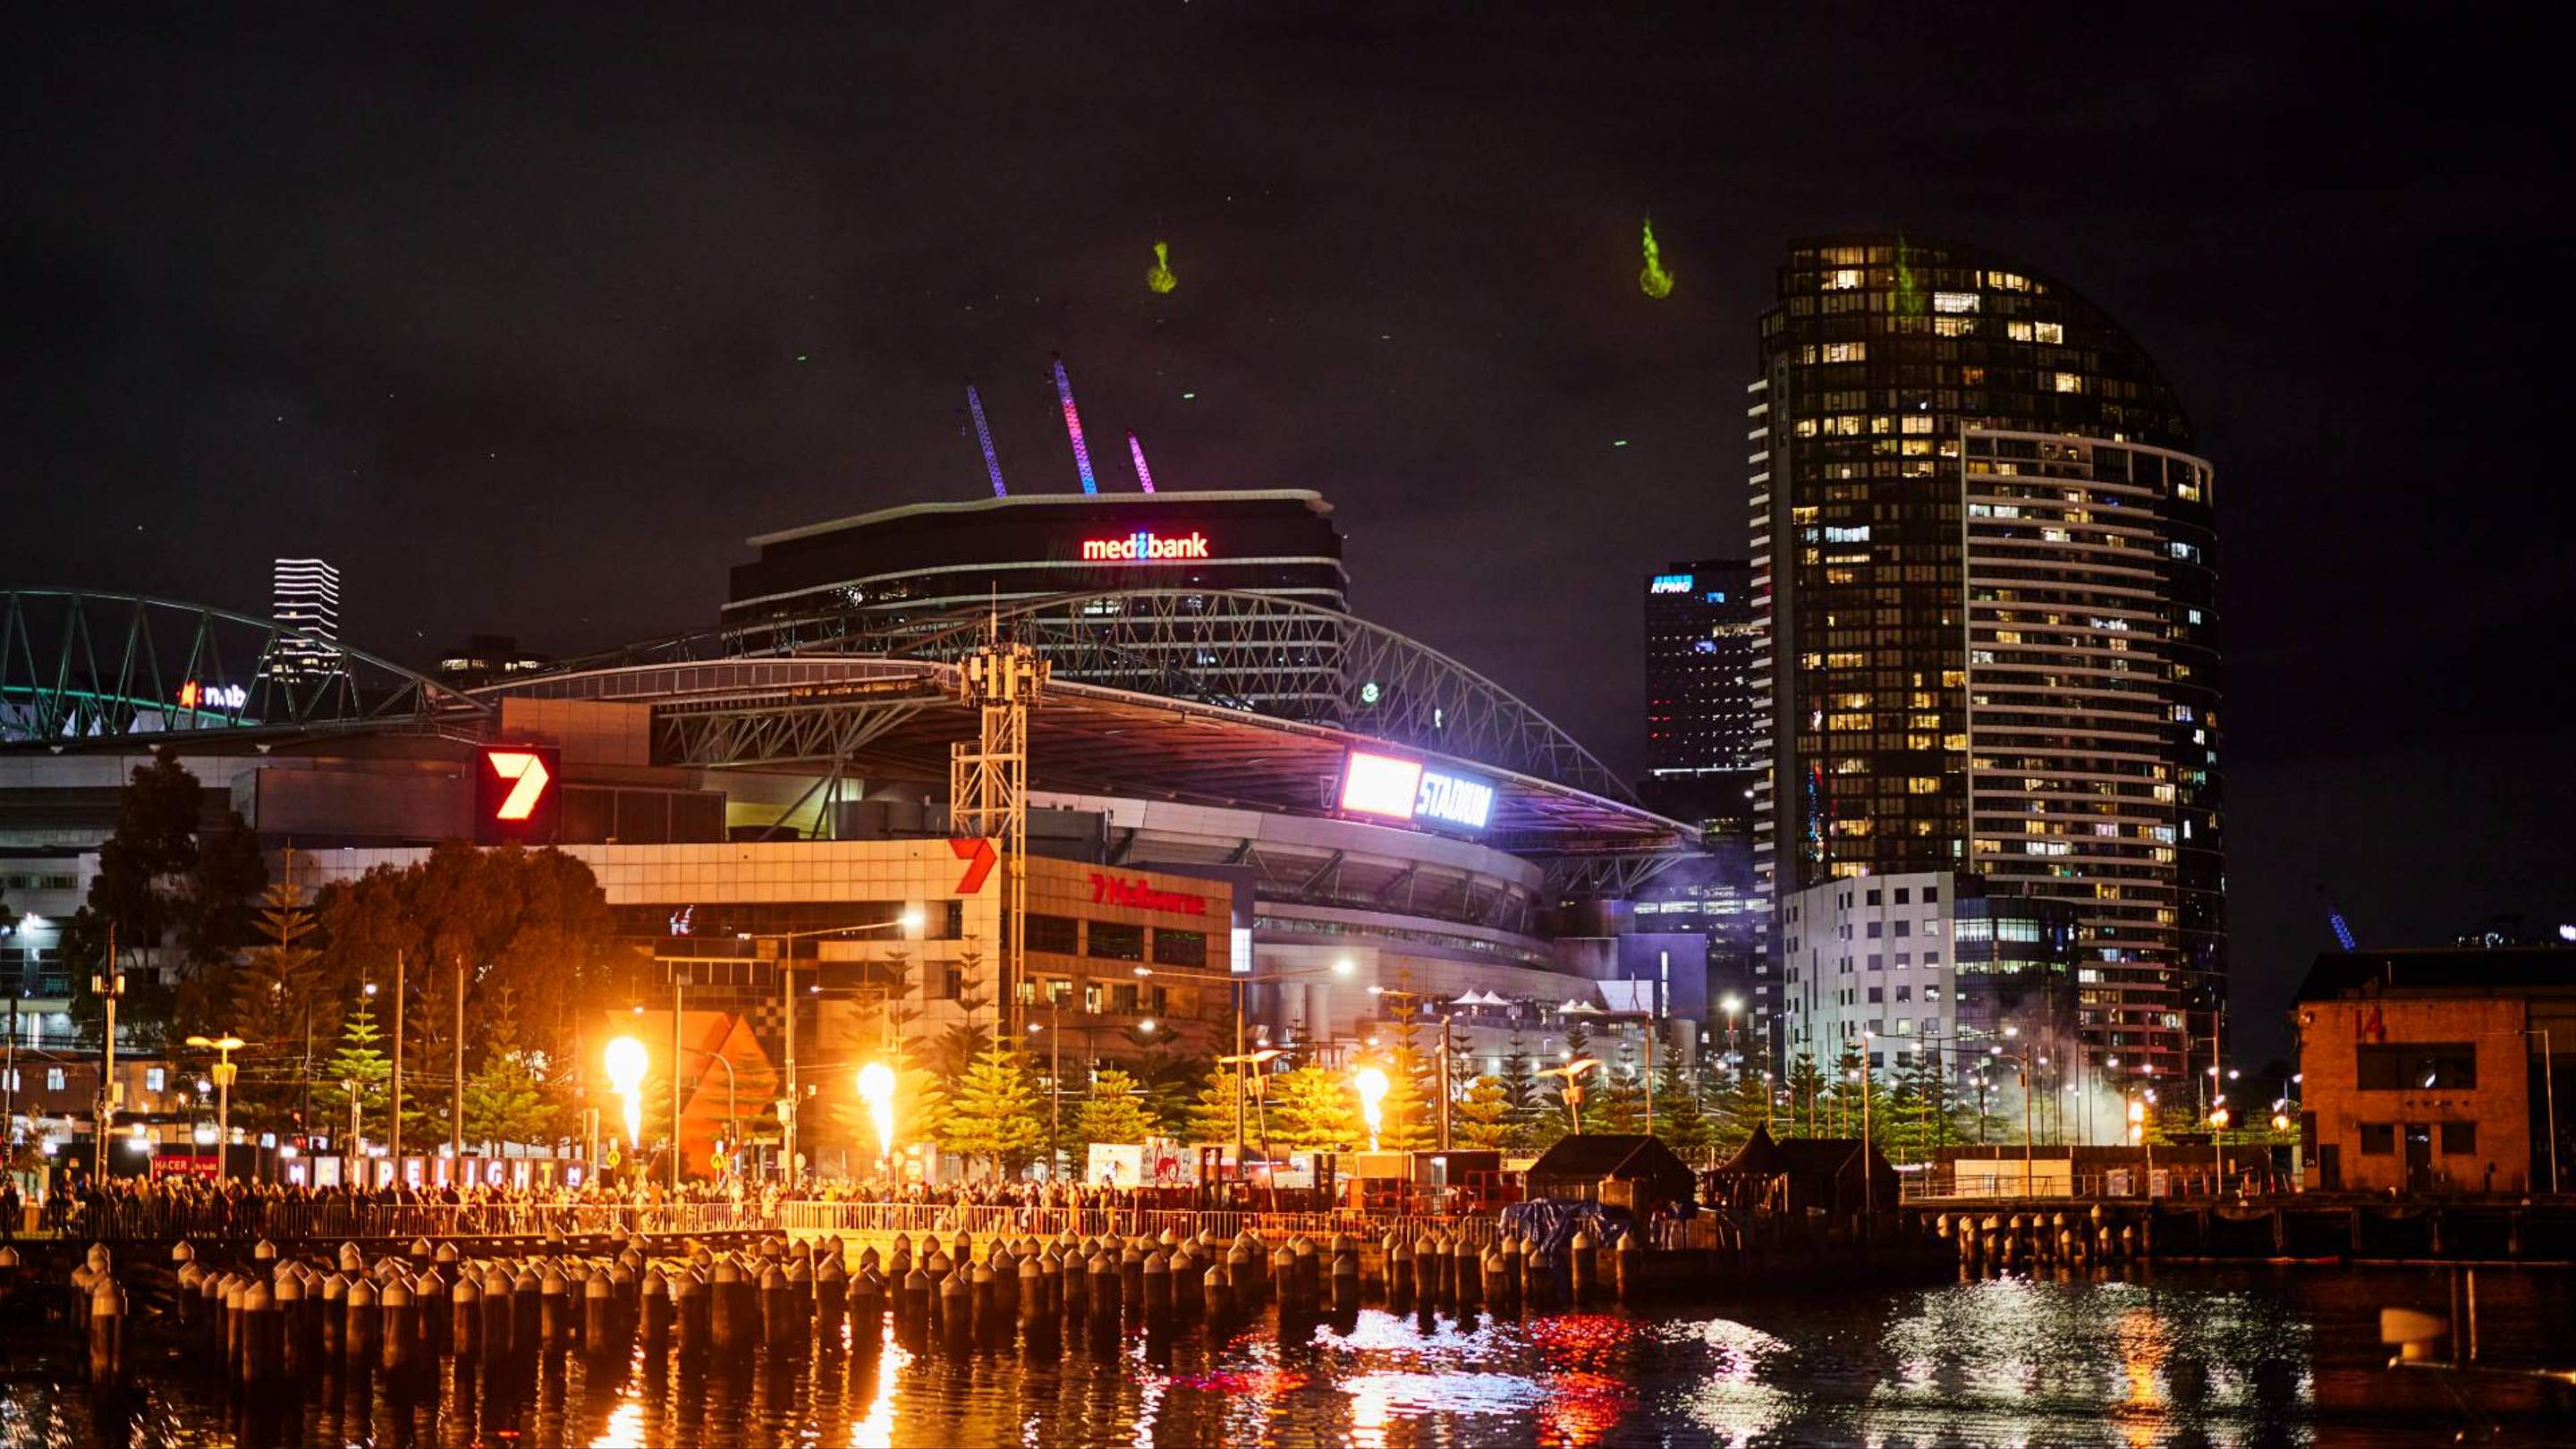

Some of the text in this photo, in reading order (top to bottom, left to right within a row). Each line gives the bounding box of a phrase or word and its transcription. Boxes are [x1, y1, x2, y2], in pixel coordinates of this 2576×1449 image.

[1083, 531, 1208, 559] medibank
[1651, 582, 1690, 593] KPMG
[487, 752, 549, 819] 7
[1415, 772, 1494, 828] STADIUM
[948, 839, 997, 894] 7
